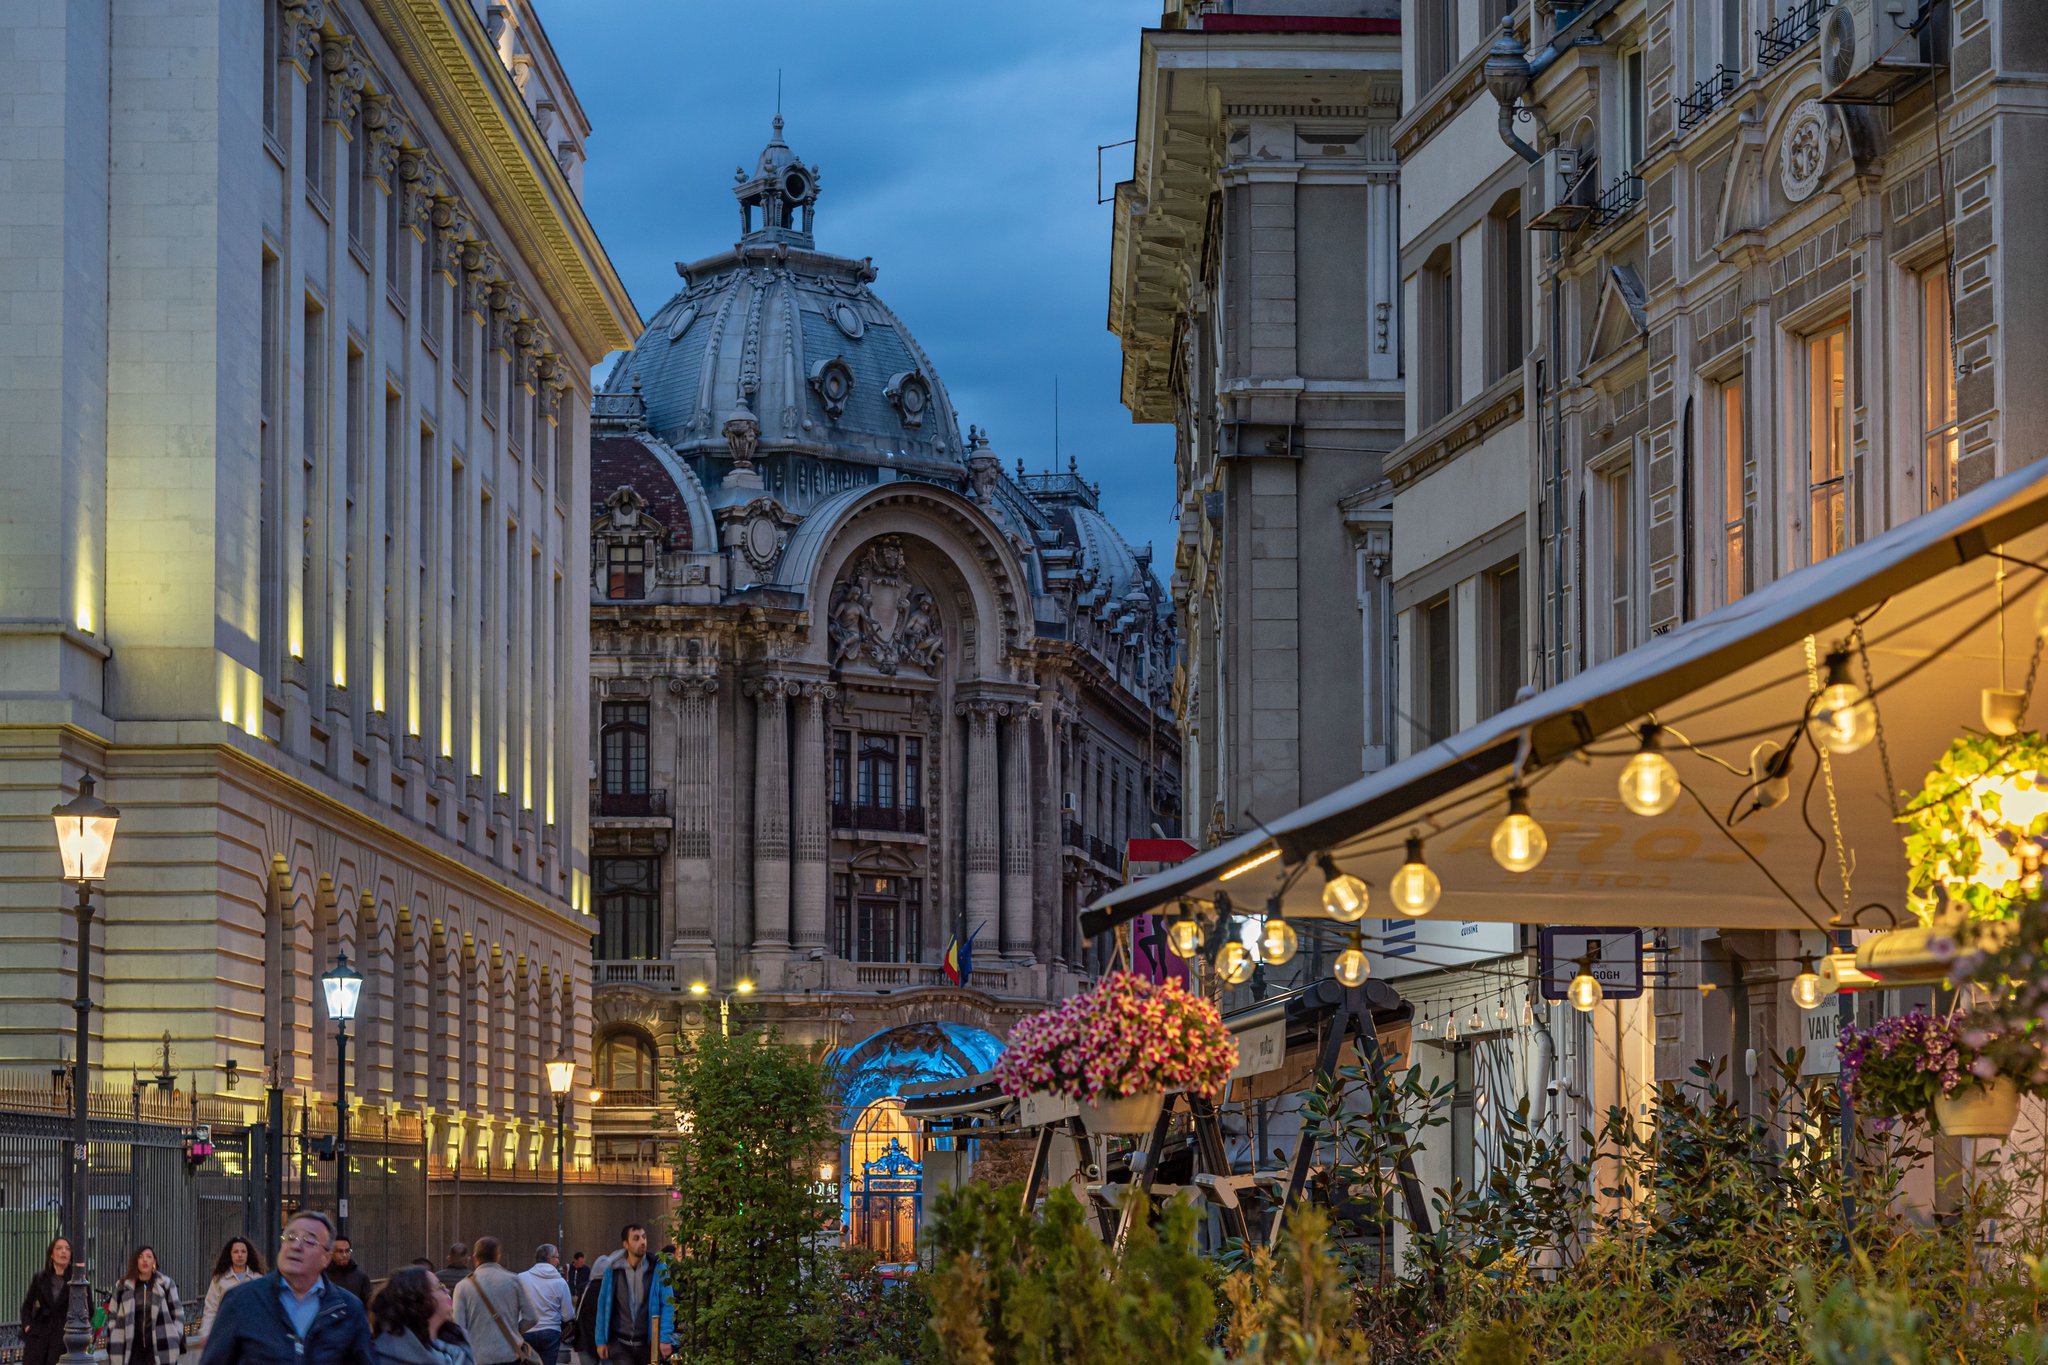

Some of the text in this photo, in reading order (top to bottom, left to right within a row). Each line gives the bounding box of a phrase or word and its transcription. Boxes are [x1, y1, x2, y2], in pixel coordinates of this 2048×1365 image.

[1461, 924, 1478, 936] CUISINE
[1593, 970, 1620, 980] GOGH
[1808, 1015, 1830, 1040] VAN
